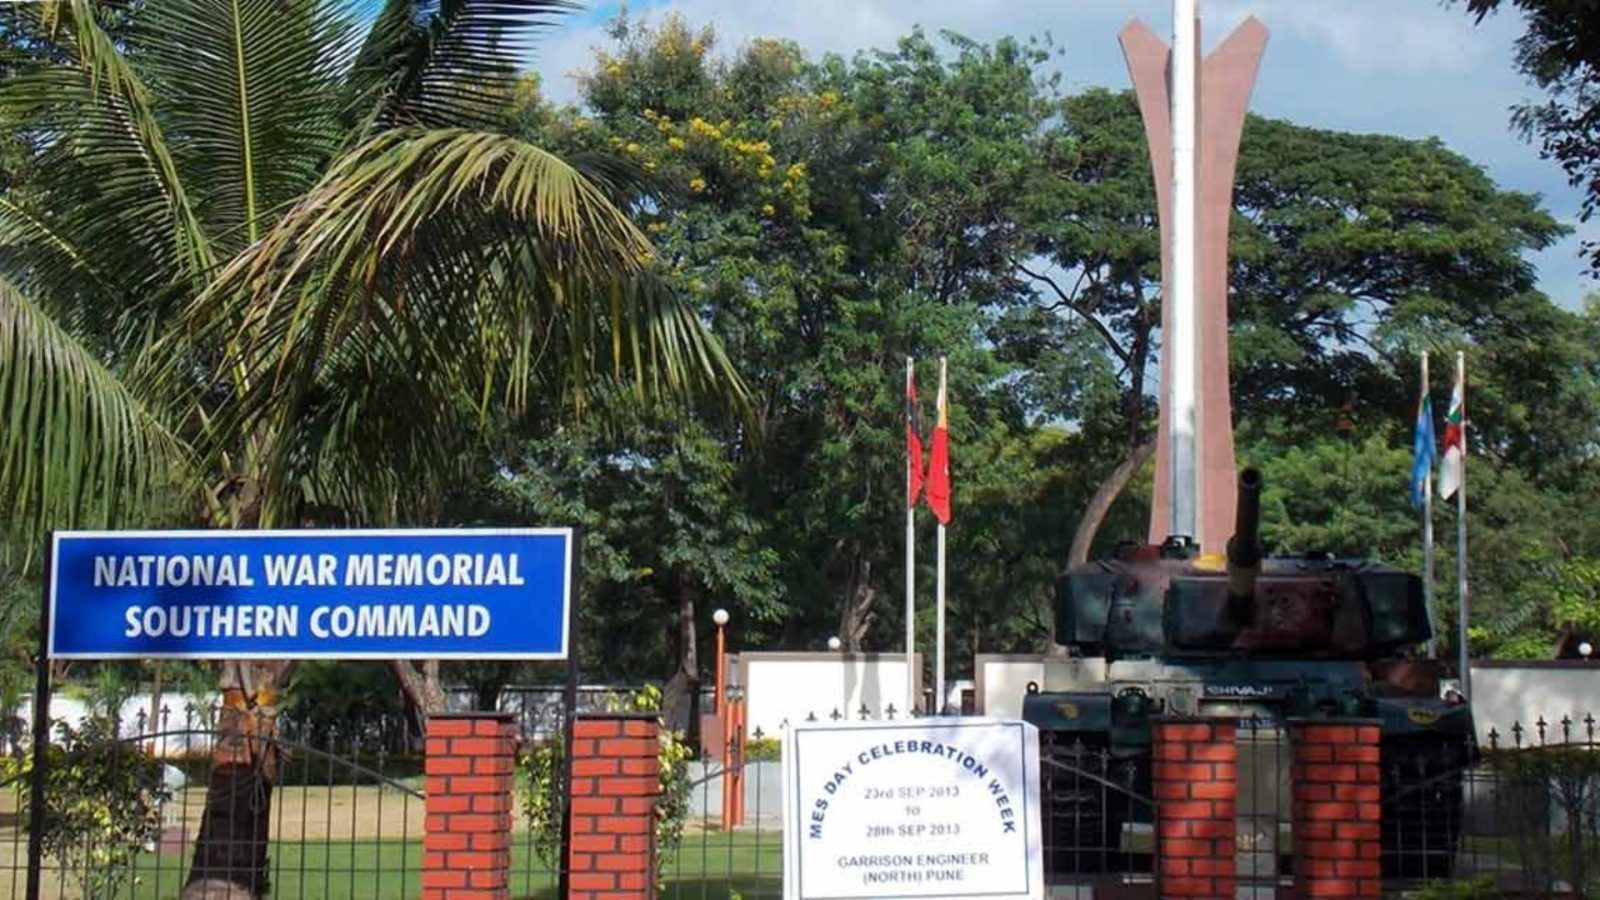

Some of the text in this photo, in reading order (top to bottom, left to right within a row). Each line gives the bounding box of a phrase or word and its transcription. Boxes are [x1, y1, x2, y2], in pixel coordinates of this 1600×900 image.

[93, 553, 524, 587] NATIONAL WAR MEMORIAL
[125, 605, 491, 639] SOUTHERN COMMAND
[809, 740, 1016, 840] MES DAY CELEBRATION WEEK
[864, 785, 960, 799] 23rd SEP 2013
[866, 824, 961, 837] 28th SEP 2013
[837, 852, 990, 868] GARRISON ENGINEER
[863, 869, 966, 884] (NORTH) PUNE
